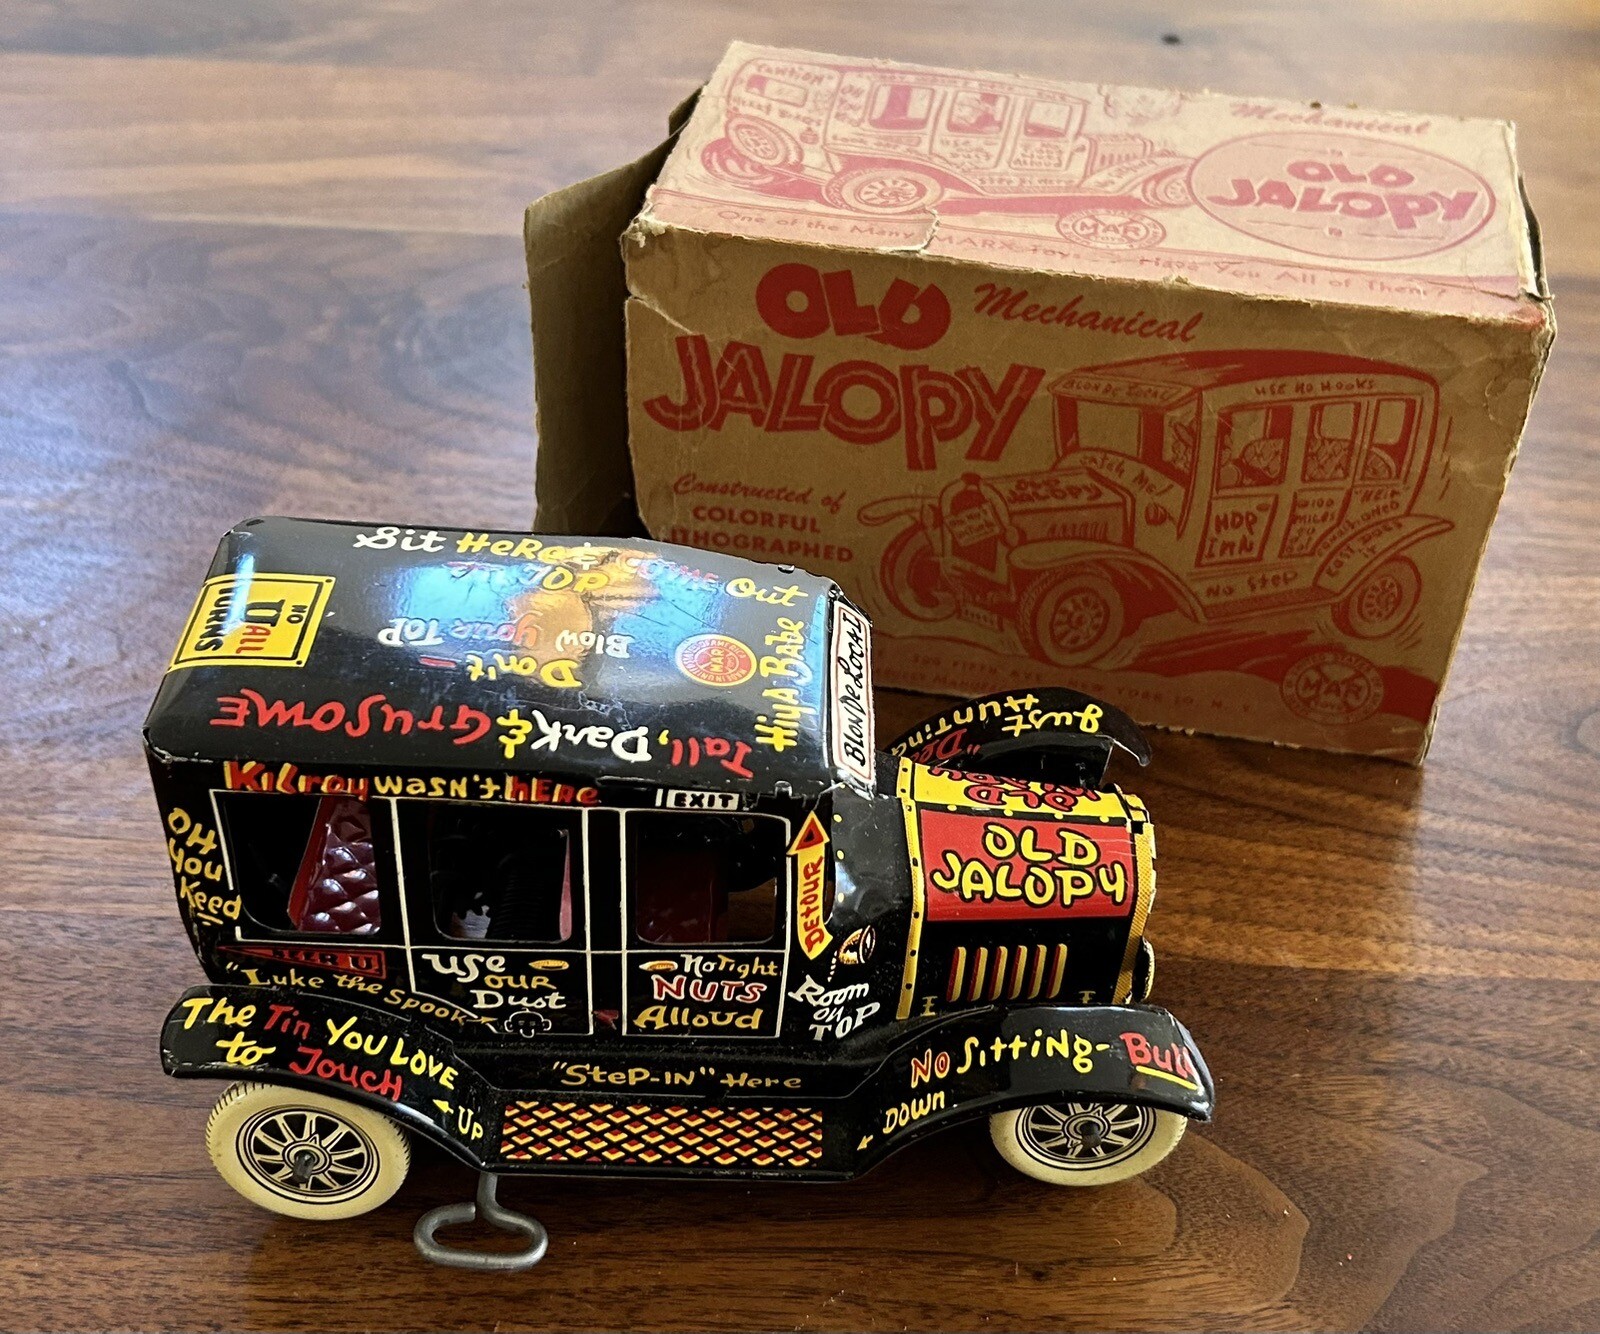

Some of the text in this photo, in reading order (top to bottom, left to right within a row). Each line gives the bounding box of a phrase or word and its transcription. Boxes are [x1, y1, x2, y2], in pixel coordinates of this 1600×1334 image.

[1287, 160, 1415, 189] OLD
[1206, 178, 1478, 231] JALOPY
[718, 210, 766, 225] One
[776, 216, 801, 228] of
[807, 219, 840, 232] the
[850, 223, 915, 241] Many
[1213, 260, 1260, 279] You
[1277, 270, 1316, 286] All
[1329, 276, 1353, 288] of
[756, 263, 952, 351] OLD
[973, 282, 1204, 343] Mechanical
[642, 334, 1047, 471] JALOPY
[673, 472, 848, 514] Constructed of
[693, 505, 822, 534] COLORFUL
[352, 526, 447, 552] Sit
[662, 526, 854, 562] ITHOGRAPHED
[724, 577, 809, 607] Out
[287, 604, 310, 624] NO
[234, 623, 273, 655] ALL
[466, 652, 583, 688] Don't
[495, 709, 533, 760] &
[223, 760, 369, 801] Kilroy
[966, 784, 1079, 812] OLD
[676, 792, 735, 809] EXIT
[167, 807, 218, 855] OH
[985, 823, 1099, 868] OLD
[933, 852, 1127, 906] JALOPY
[333, 973, 383, 993] the
[383, 988, 466, 1026] Spook
[470, 989, 567, 1010] Dust
[651, 973, 768, 1003] NUTS
[788, 975, 870, 1007] Room
[182, 997, 257, 1029] The
[264, 1004, 311, 1040] Tin
[216, 1031, 277, 1067] to
[720, 1071, 802, 1089] Here
